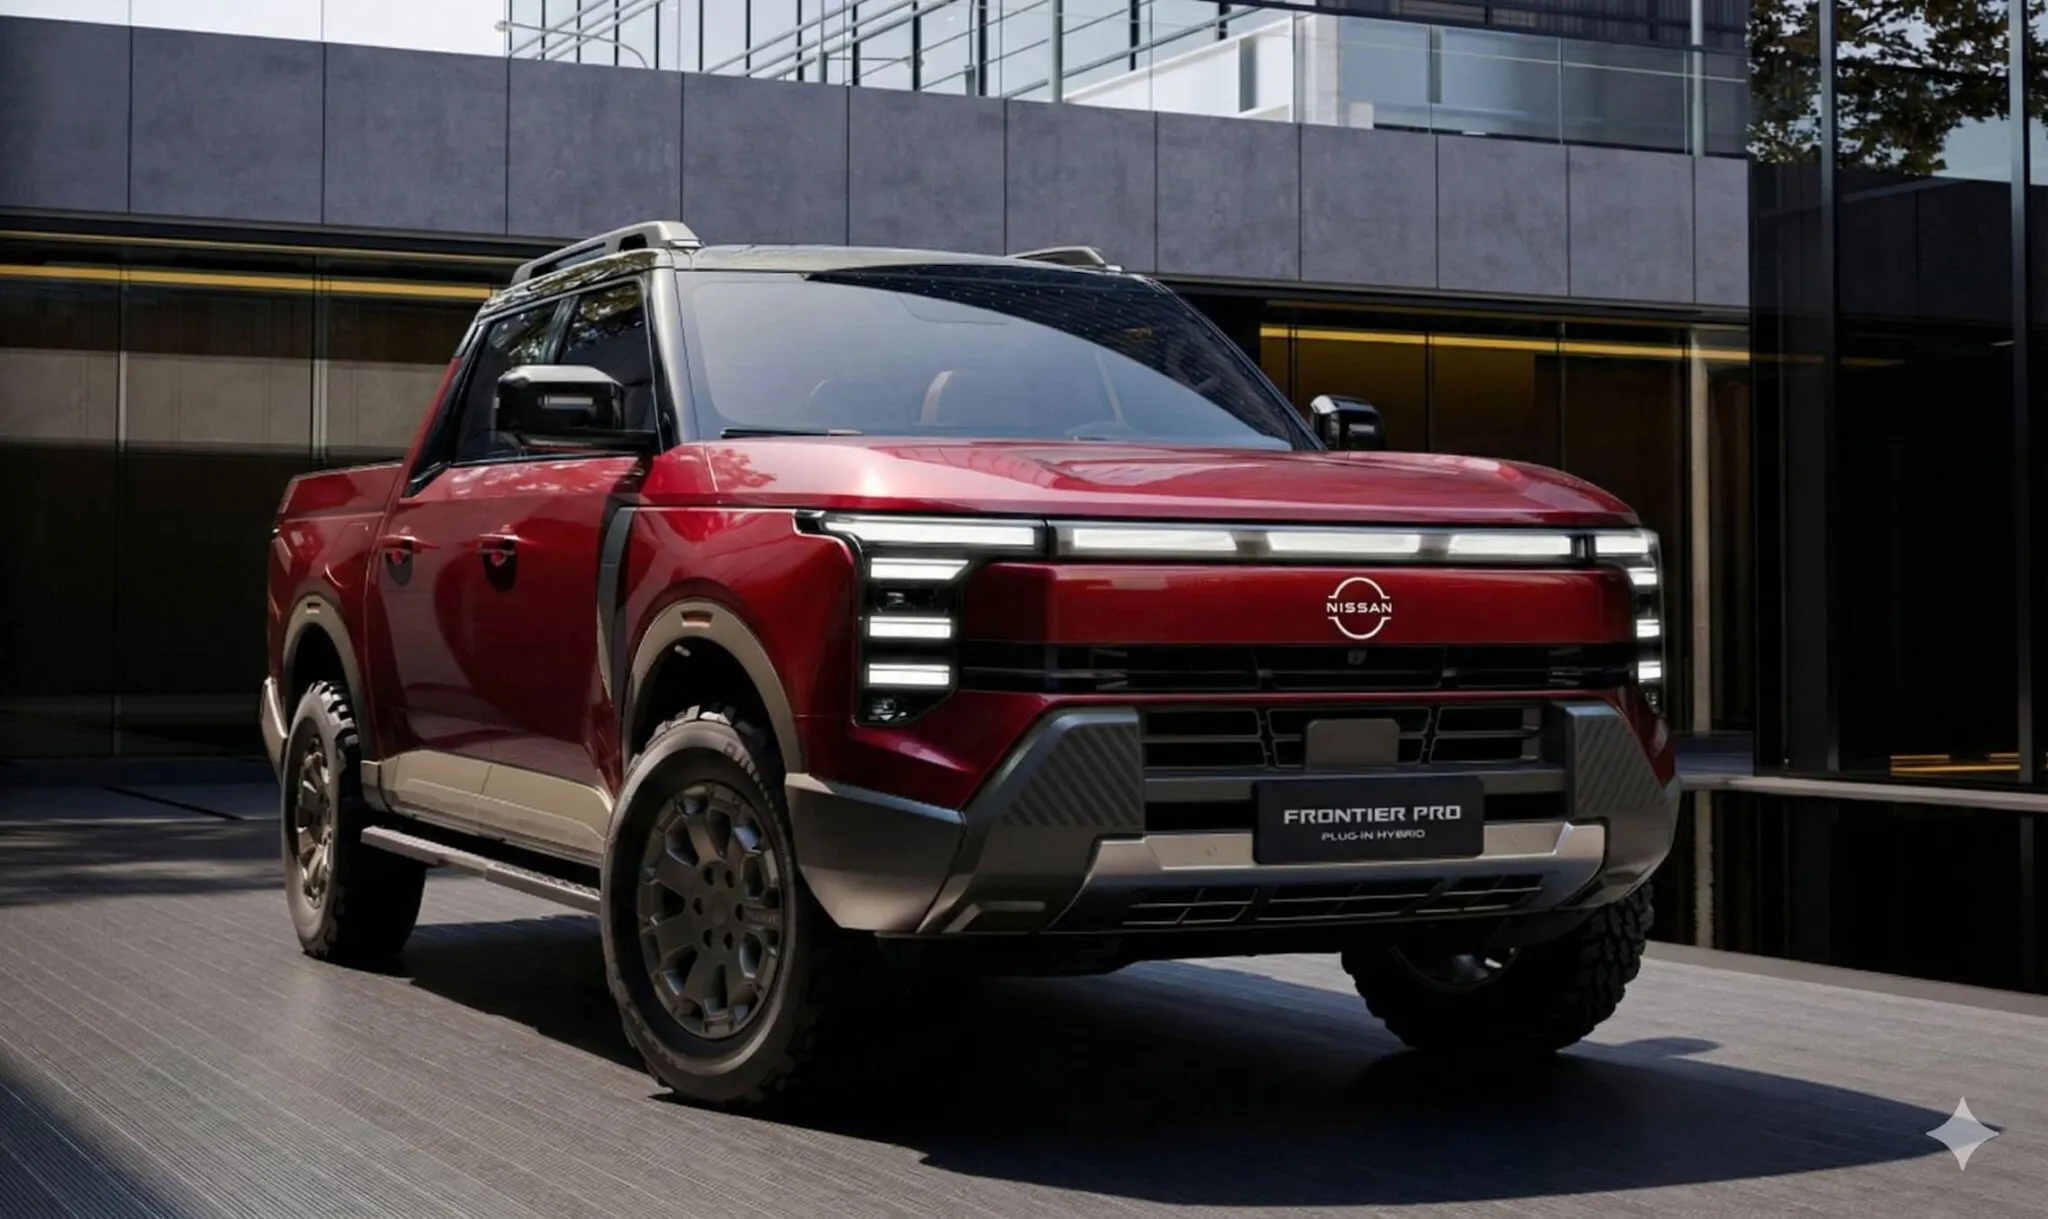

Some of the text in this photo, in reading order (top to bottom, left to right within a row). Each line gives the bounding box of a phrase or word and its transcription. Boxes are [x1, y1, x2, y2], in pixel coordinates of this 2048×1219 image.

[1326, 602, 1393, 614] NISSAN
[1283, 805, 1462, 825] FRONTIER PRO
[1321, 829, 1426, 842] PLUG-IN HYBRID
